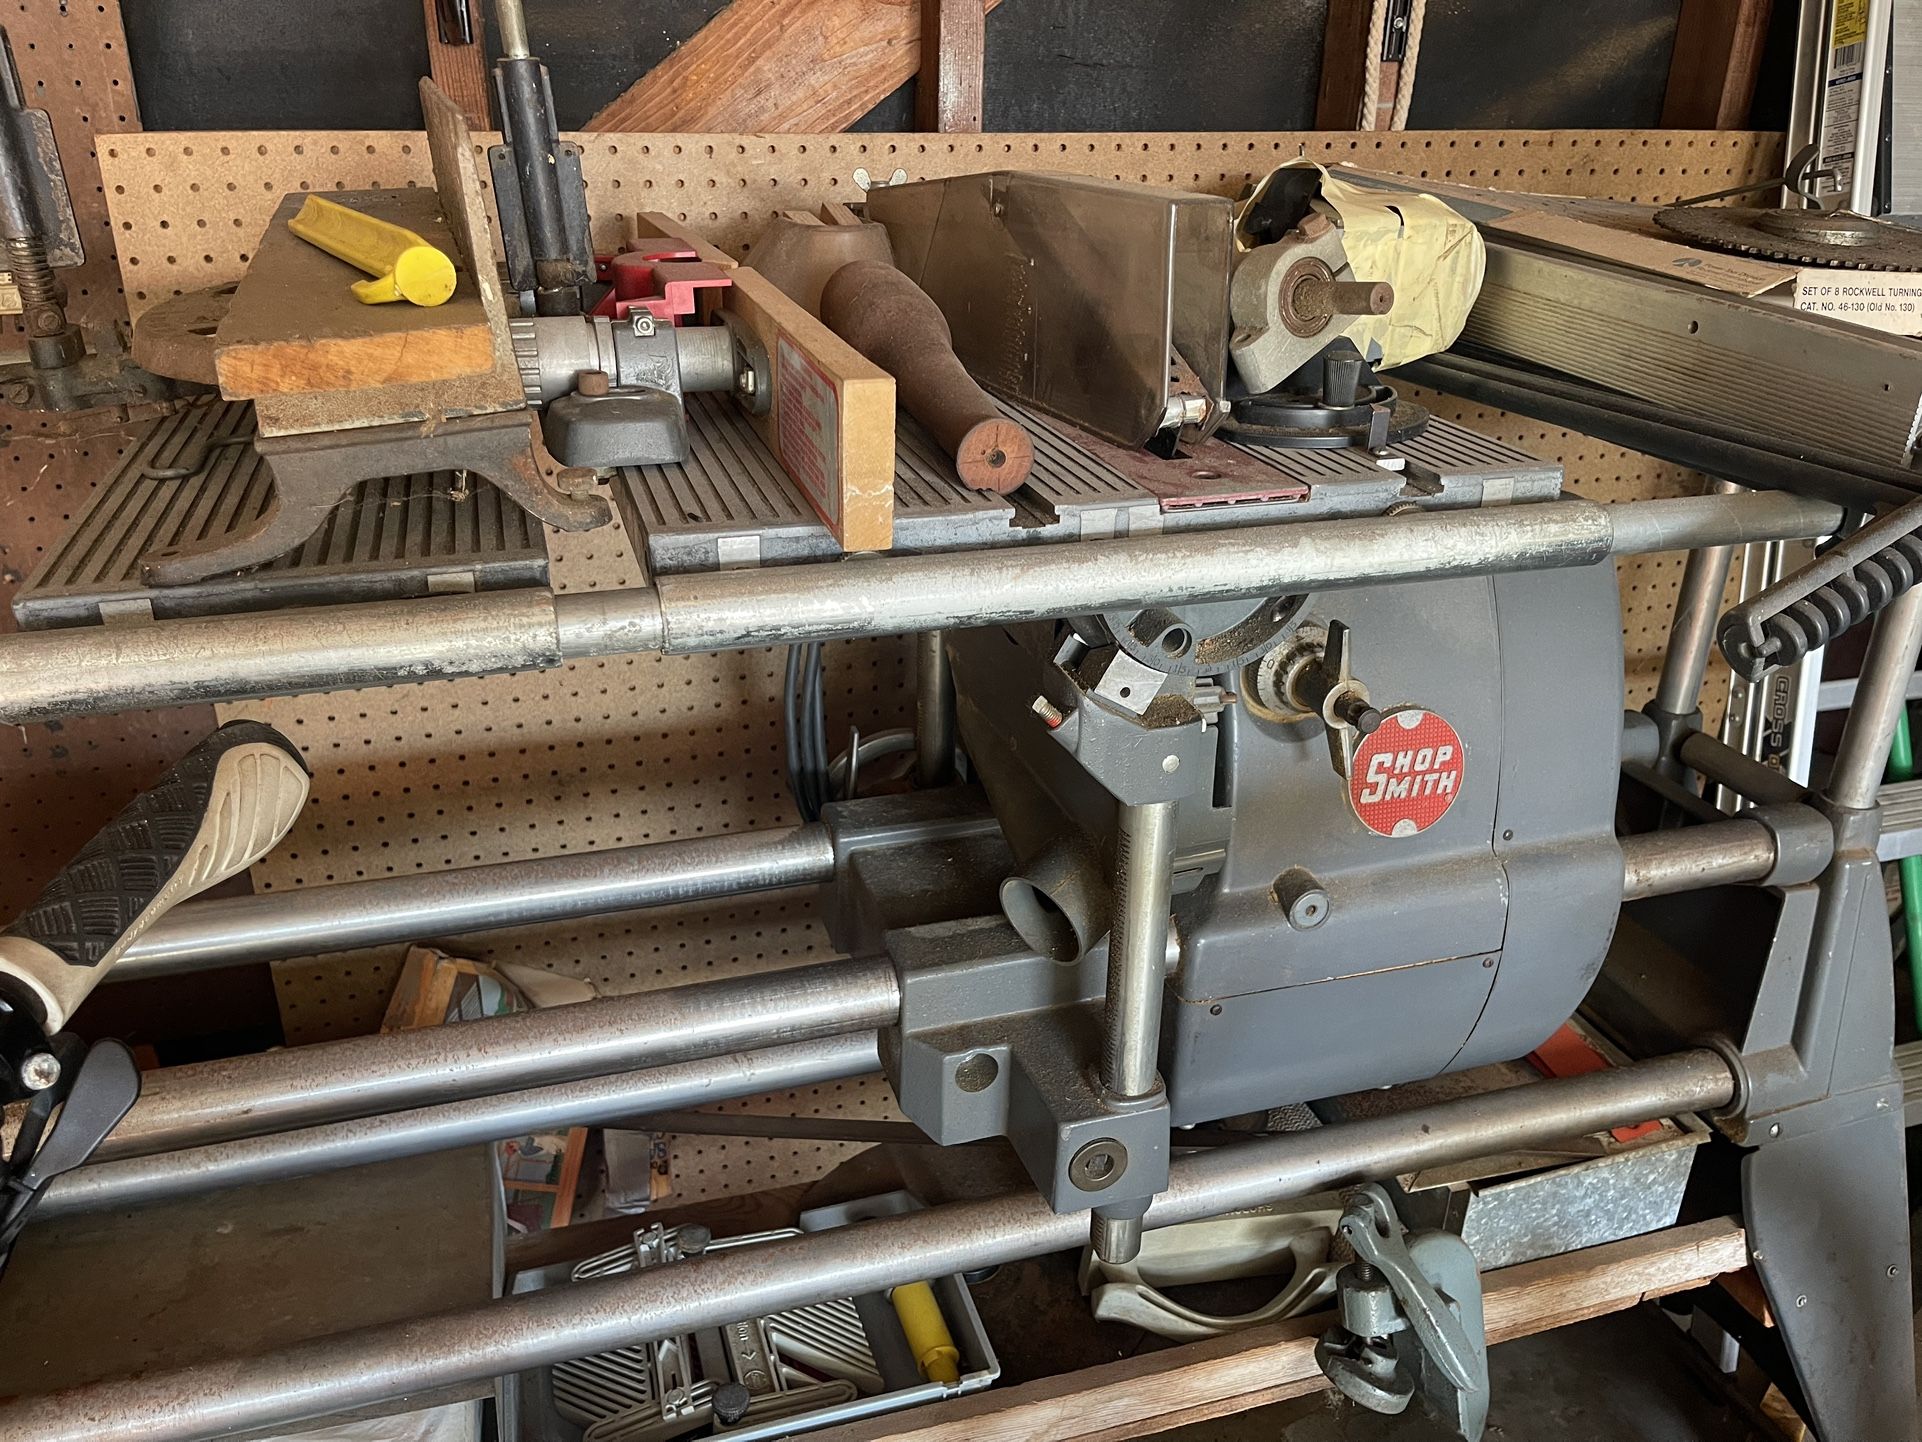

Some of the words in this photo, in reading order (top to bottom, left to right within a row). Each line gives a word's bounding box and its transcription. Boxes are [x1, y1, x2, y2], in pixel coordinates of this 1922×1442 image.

[1800, 301, 1818, 311] CAT.
[1821, 302, 1836, 311] NO.
[1839, 302, 1865, 312] 46-130
[1867, 302, 1883, 312] (Old
[1885, 303, 1897, 312] No.
[1899, 303, 1915, 313] 130)
[1802, 286, 1818, 296] SET
[1820, 286, 1832, 296] OF
[1834, 287, 1840, 296] 8
[1842, 287, 1886, 297] ROCKWELL
[1888, 287, 1922, 297] TURNING
[1771, 676, 1789, 748] CROSS
[1366, 745, 1453, 785] SHOP
[1359, 770, 1457, 804] SMITH
